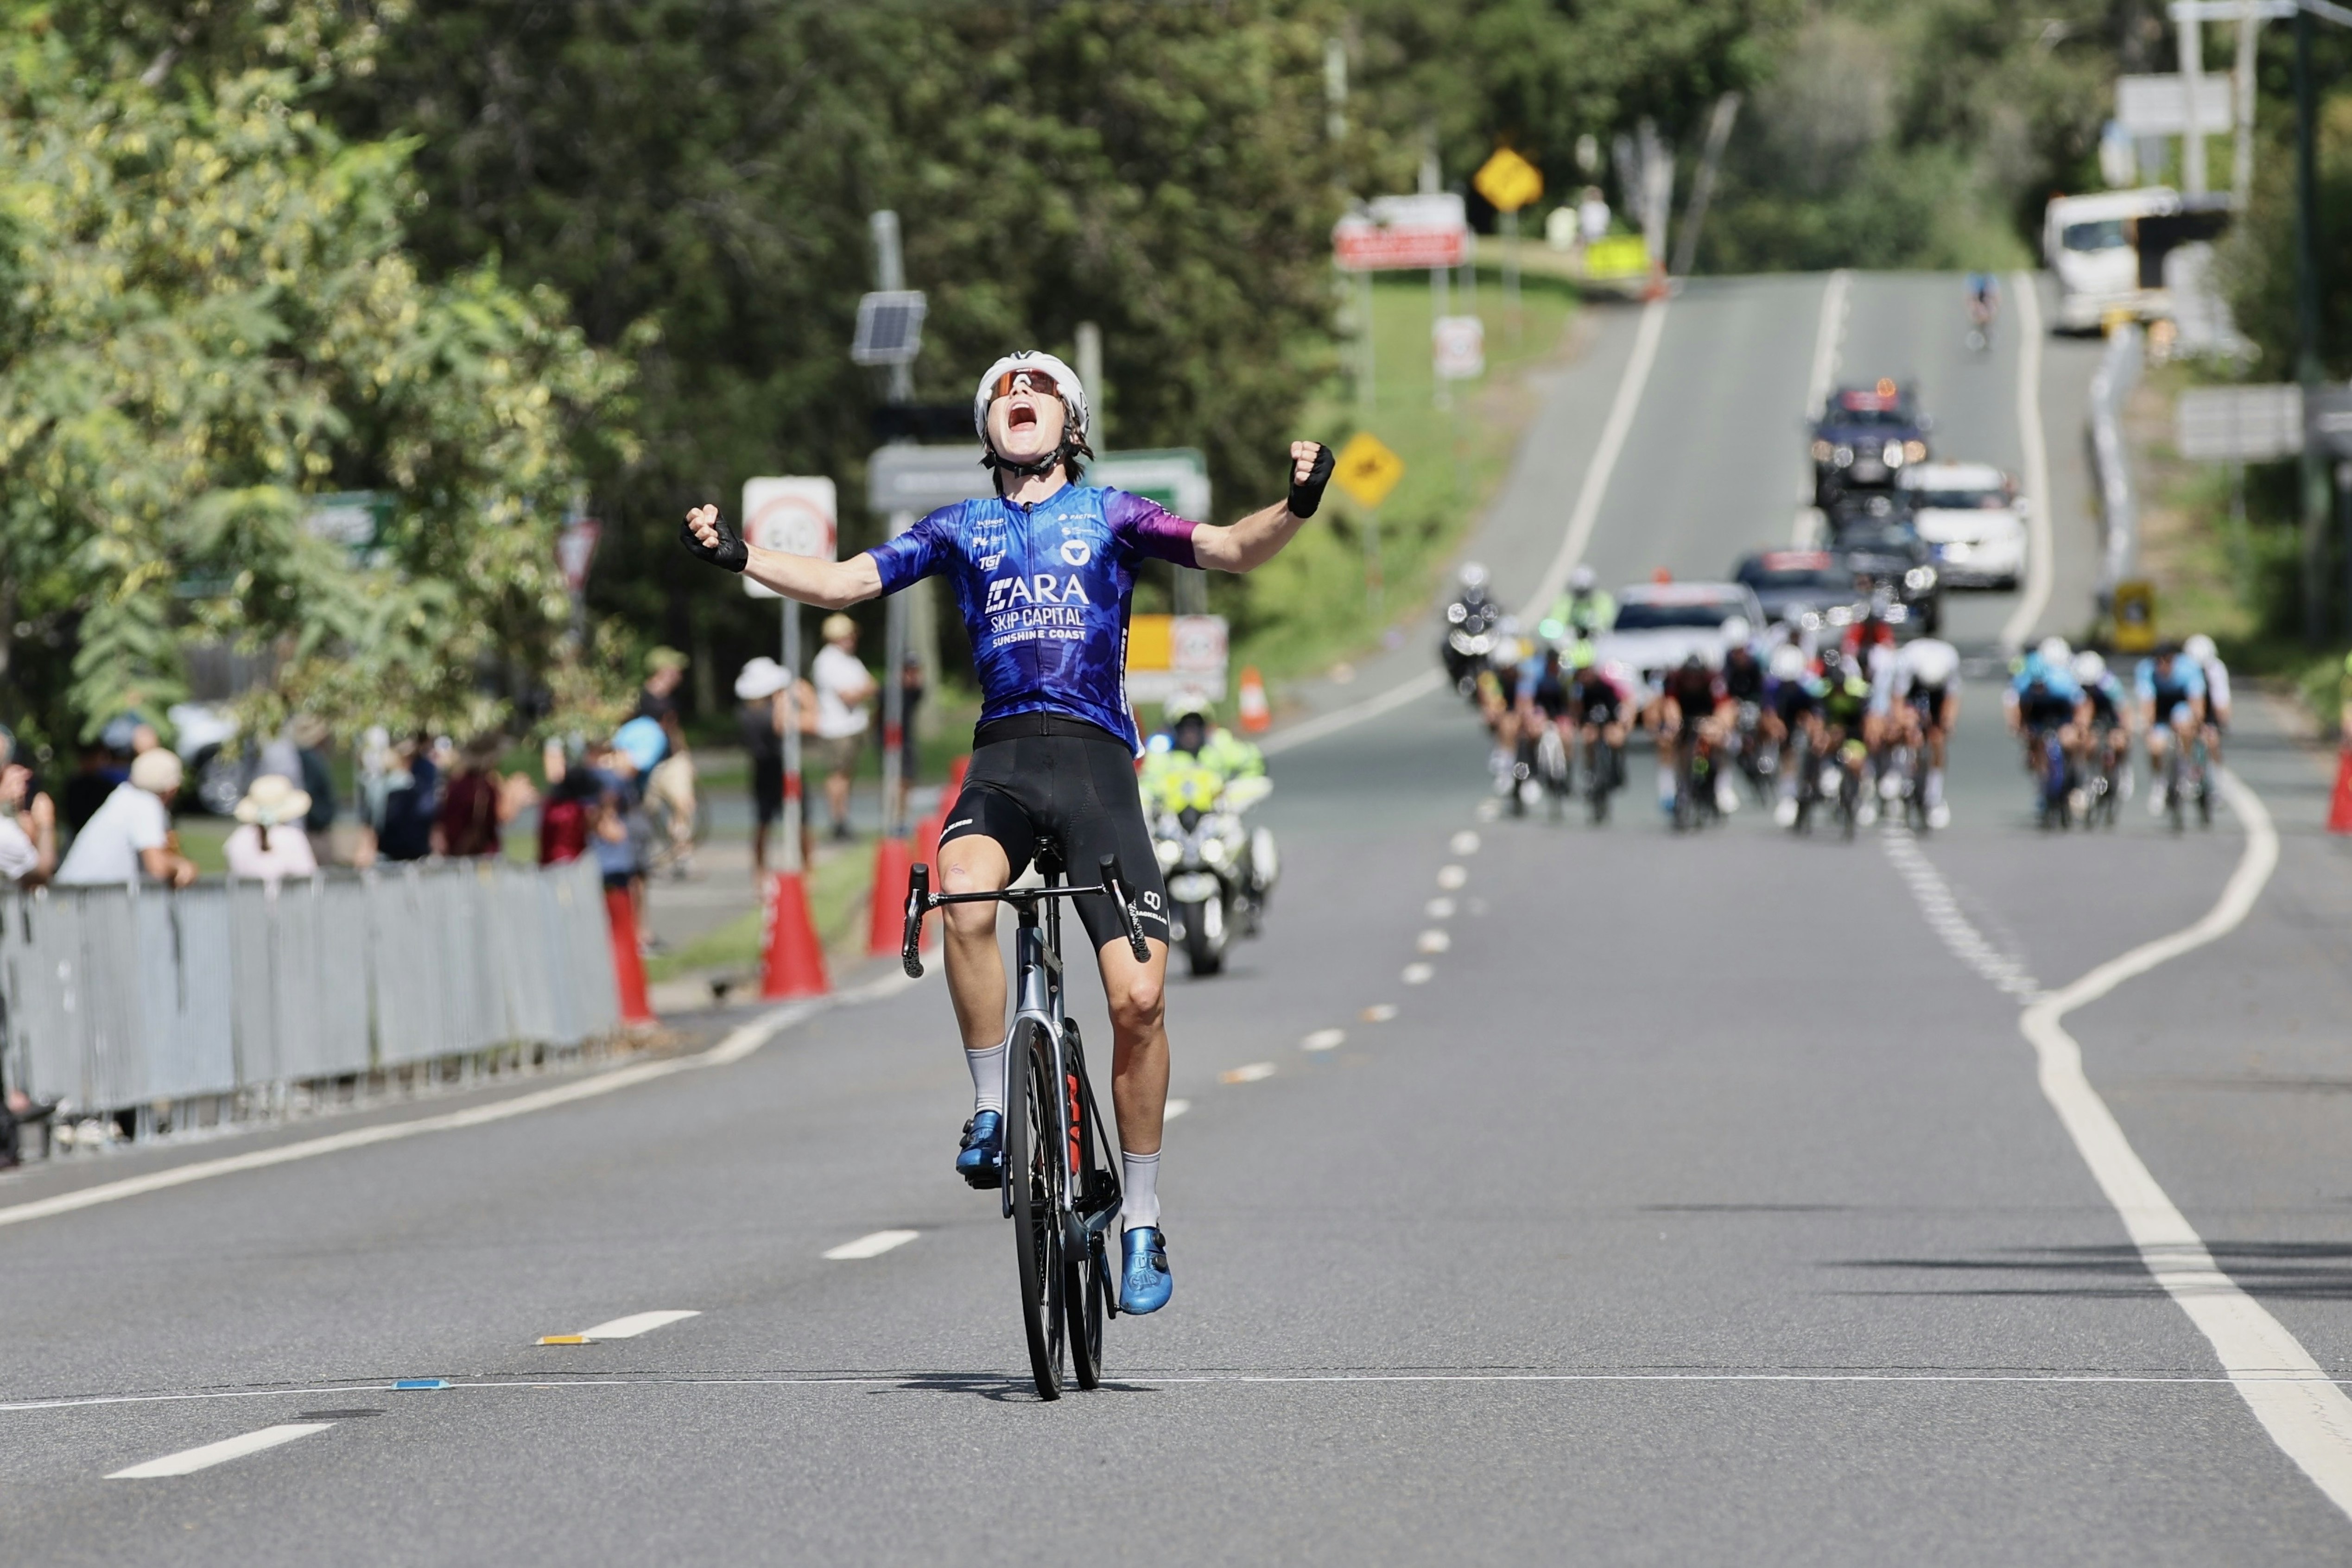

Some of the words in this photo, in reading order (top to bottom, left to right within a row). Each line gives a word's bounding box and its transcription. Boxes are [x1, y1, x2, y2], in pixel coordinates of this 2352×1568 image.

[979, 553, 1002, 570] TGI
[1007, 573, 1090, 608] ARA
[990, 611, 1019, 634] SKIP
[1022, 607, 1085, 626] CAPITAL
[992, 629, 1045, 648] SUNSHINE
[1049, 629, 1086, 640] COAST
